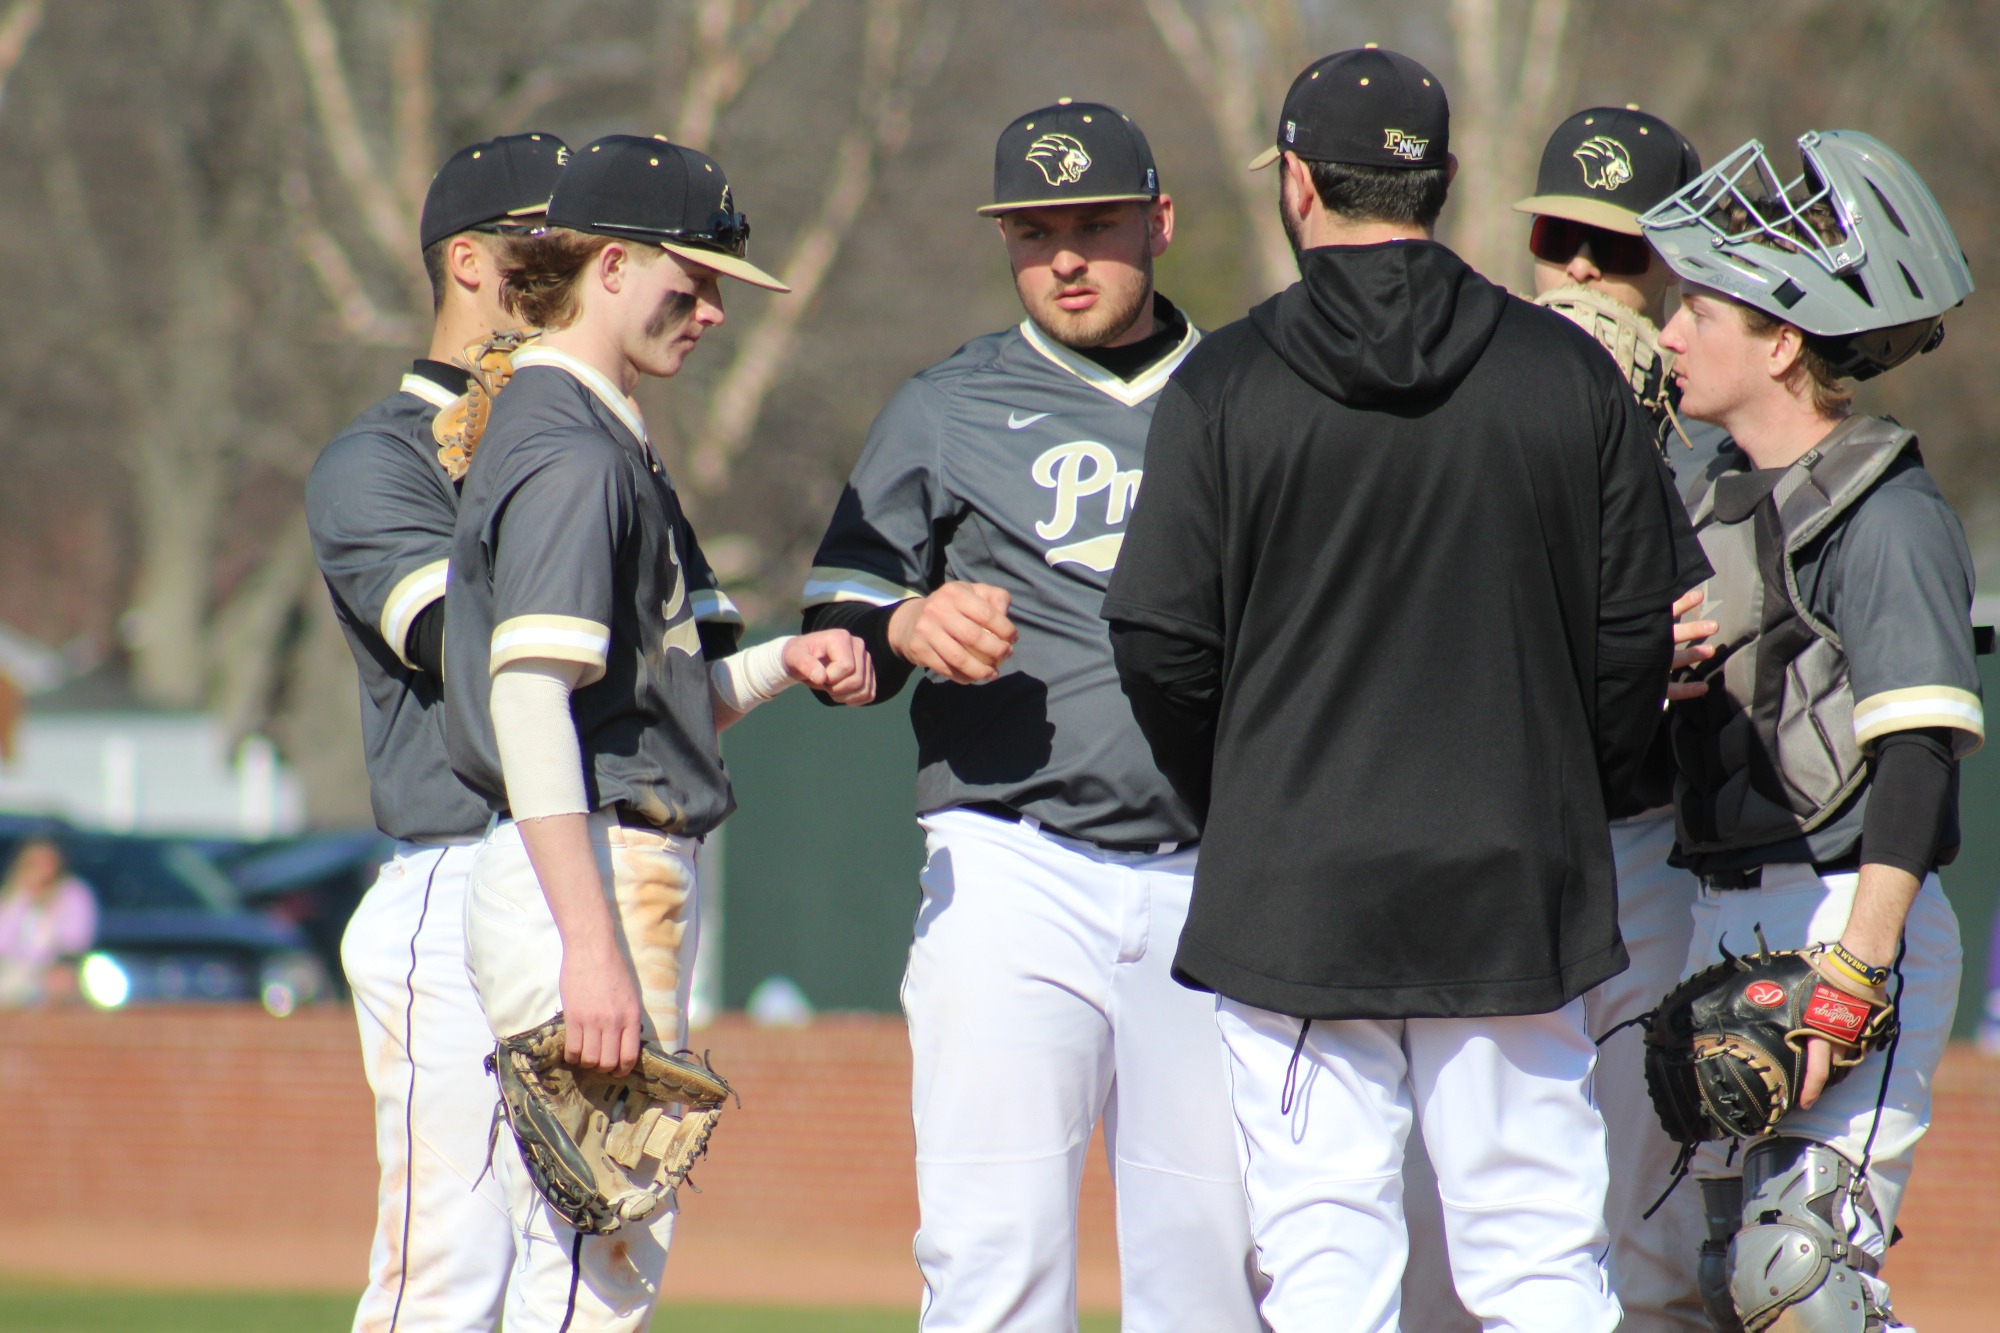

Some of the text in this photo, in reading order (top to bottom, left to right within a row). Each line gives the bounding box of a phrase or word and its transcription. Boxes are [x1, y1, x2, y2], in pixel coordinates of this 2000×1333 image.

[1384, 129, 1429, 160] PNW
[1841, 951, 1868, 973] DREAM
[1813, 1003, 1861, 1028] Rawlings
